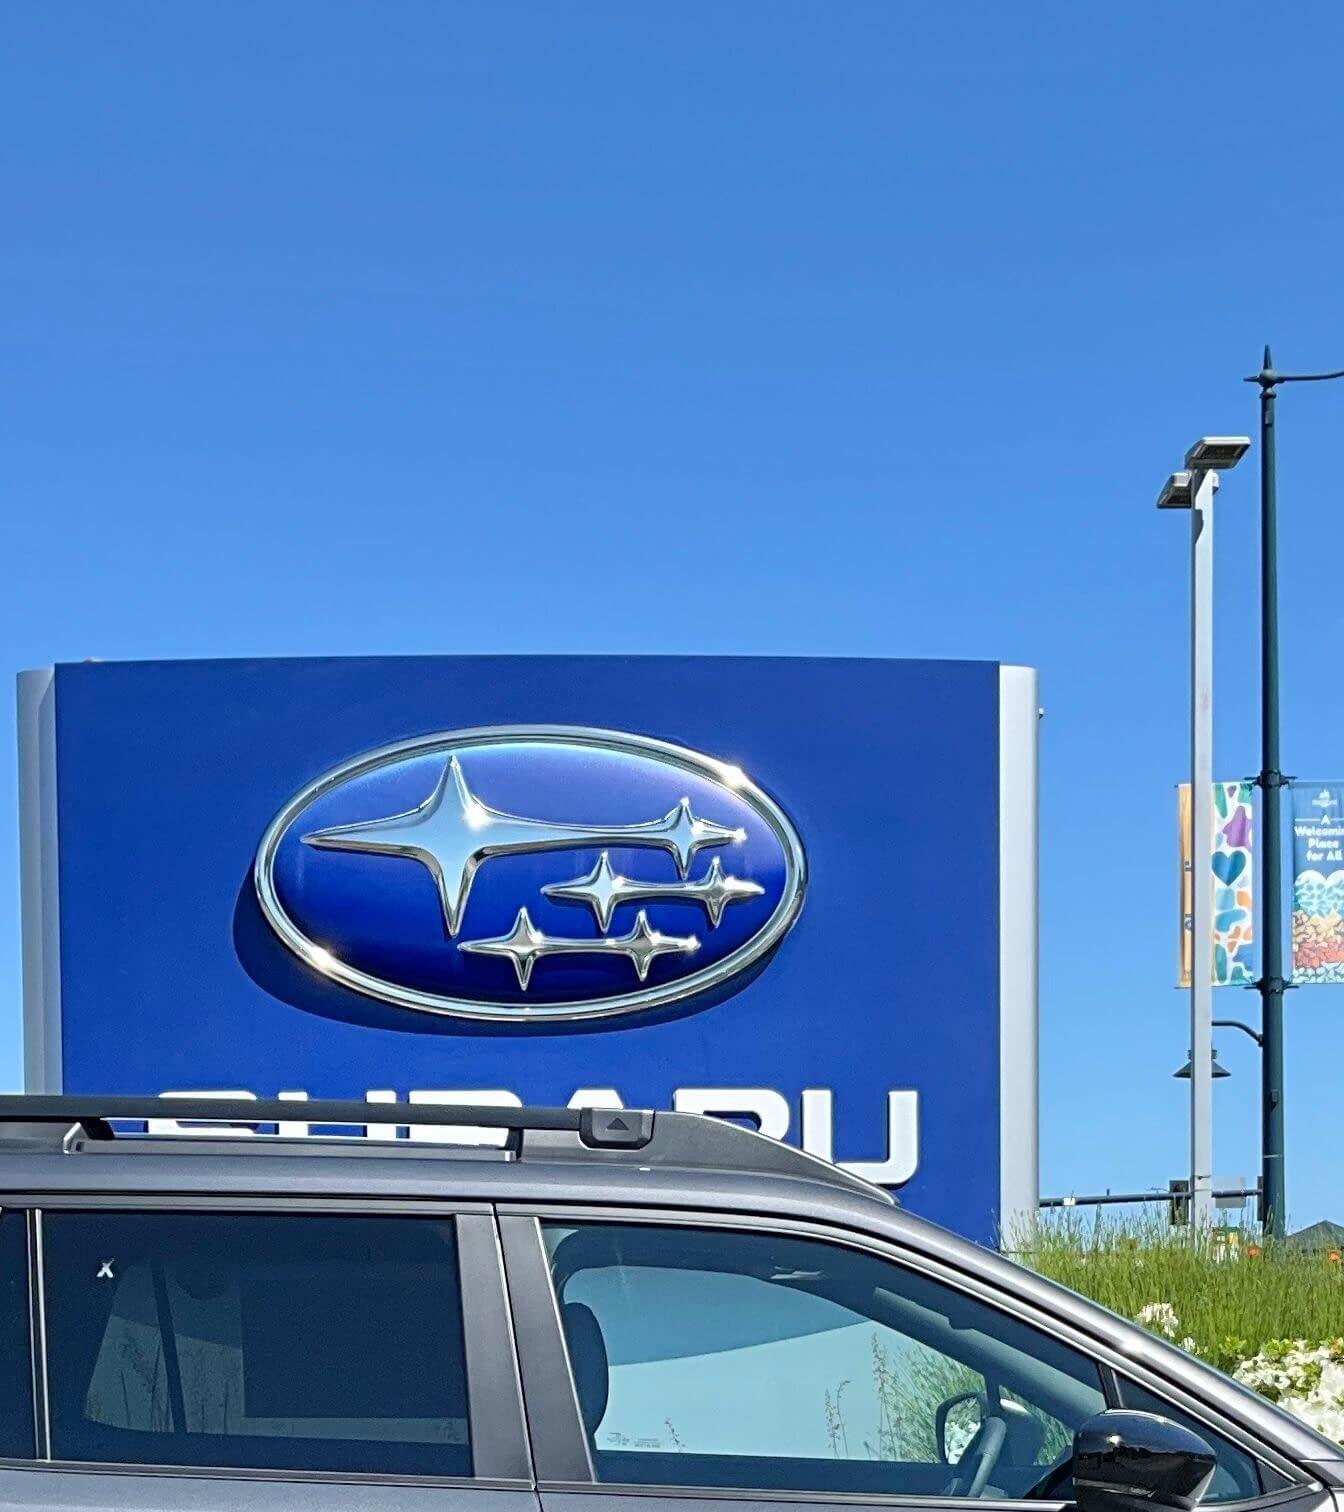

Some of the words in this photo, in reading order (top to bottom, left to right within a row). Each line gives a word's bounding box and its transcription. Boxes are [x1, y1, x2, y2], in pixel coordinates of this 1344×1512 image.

[1320, 814, 1331, 825] A
[1308, 838, 1339, 849] Place
[1306, 850, 1324, 861] for
[1326, 850, 1343, 861] All
